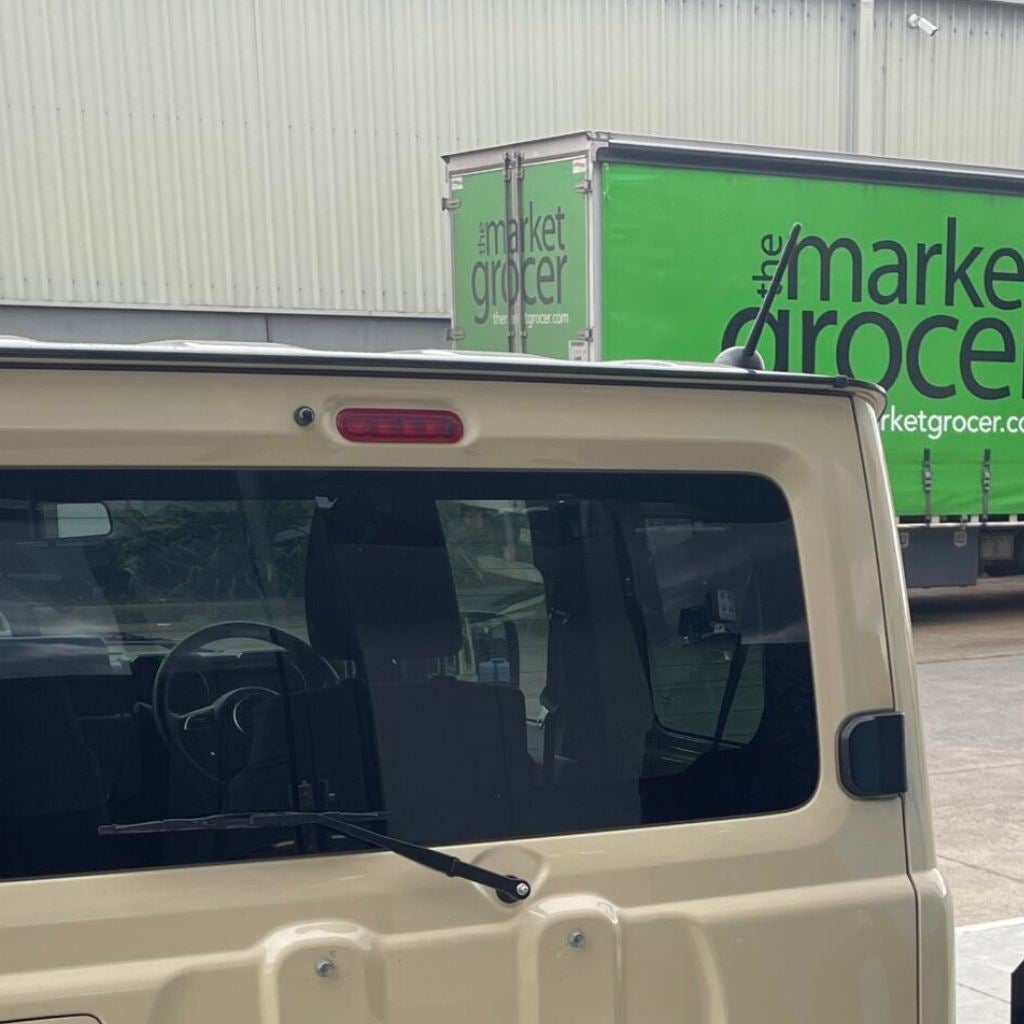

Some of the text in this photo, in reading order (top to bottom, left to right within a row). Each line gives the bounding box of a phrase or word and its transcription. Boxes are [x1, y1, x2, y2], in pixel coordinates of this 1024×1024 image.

[486, 201, 565, 256] market
[472, 254, 568, 325] grocer
[752, 233, 783, 299] the
